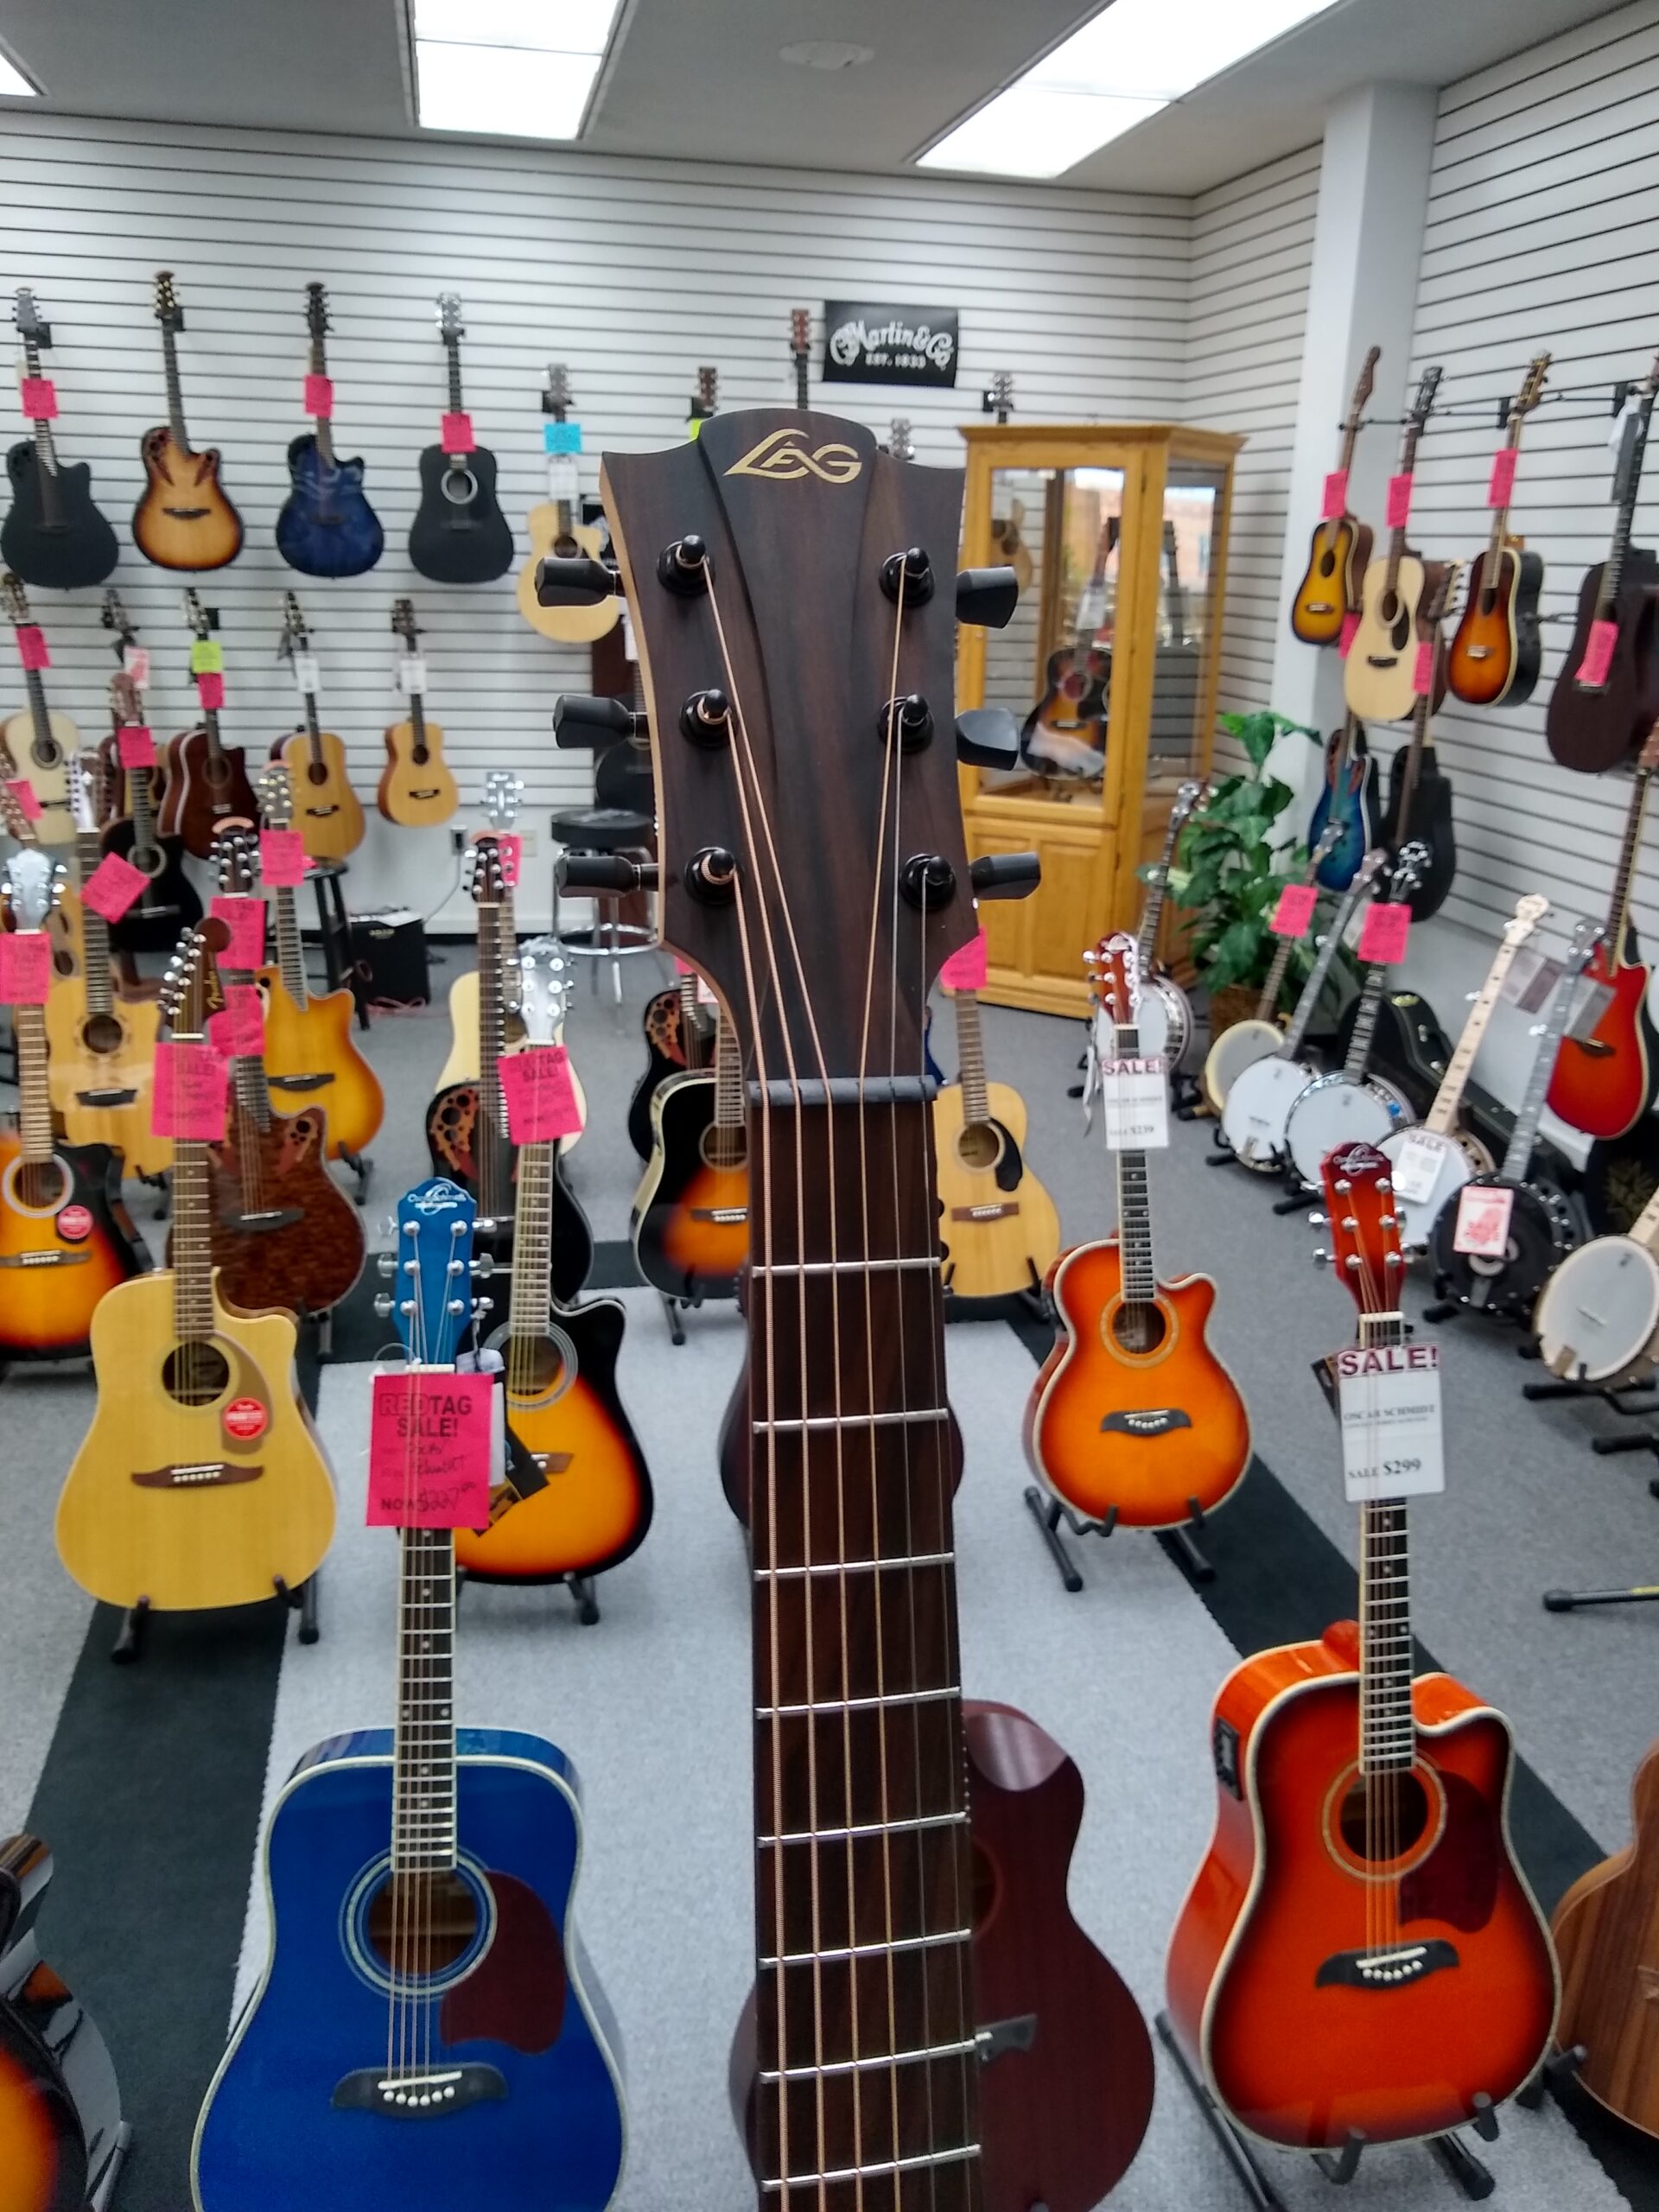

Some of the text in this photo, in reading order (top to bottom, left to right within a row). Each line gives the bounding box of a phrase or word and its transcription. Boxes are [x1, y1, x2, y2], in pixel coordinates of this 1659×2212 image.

[1342, 1348, 1438, 1376] SALE!
[429, 1395, 472, 1415] TAG
[397, 1417, 459, 1438] SALE!
[1382, 1457, 1422, 1476] $299
